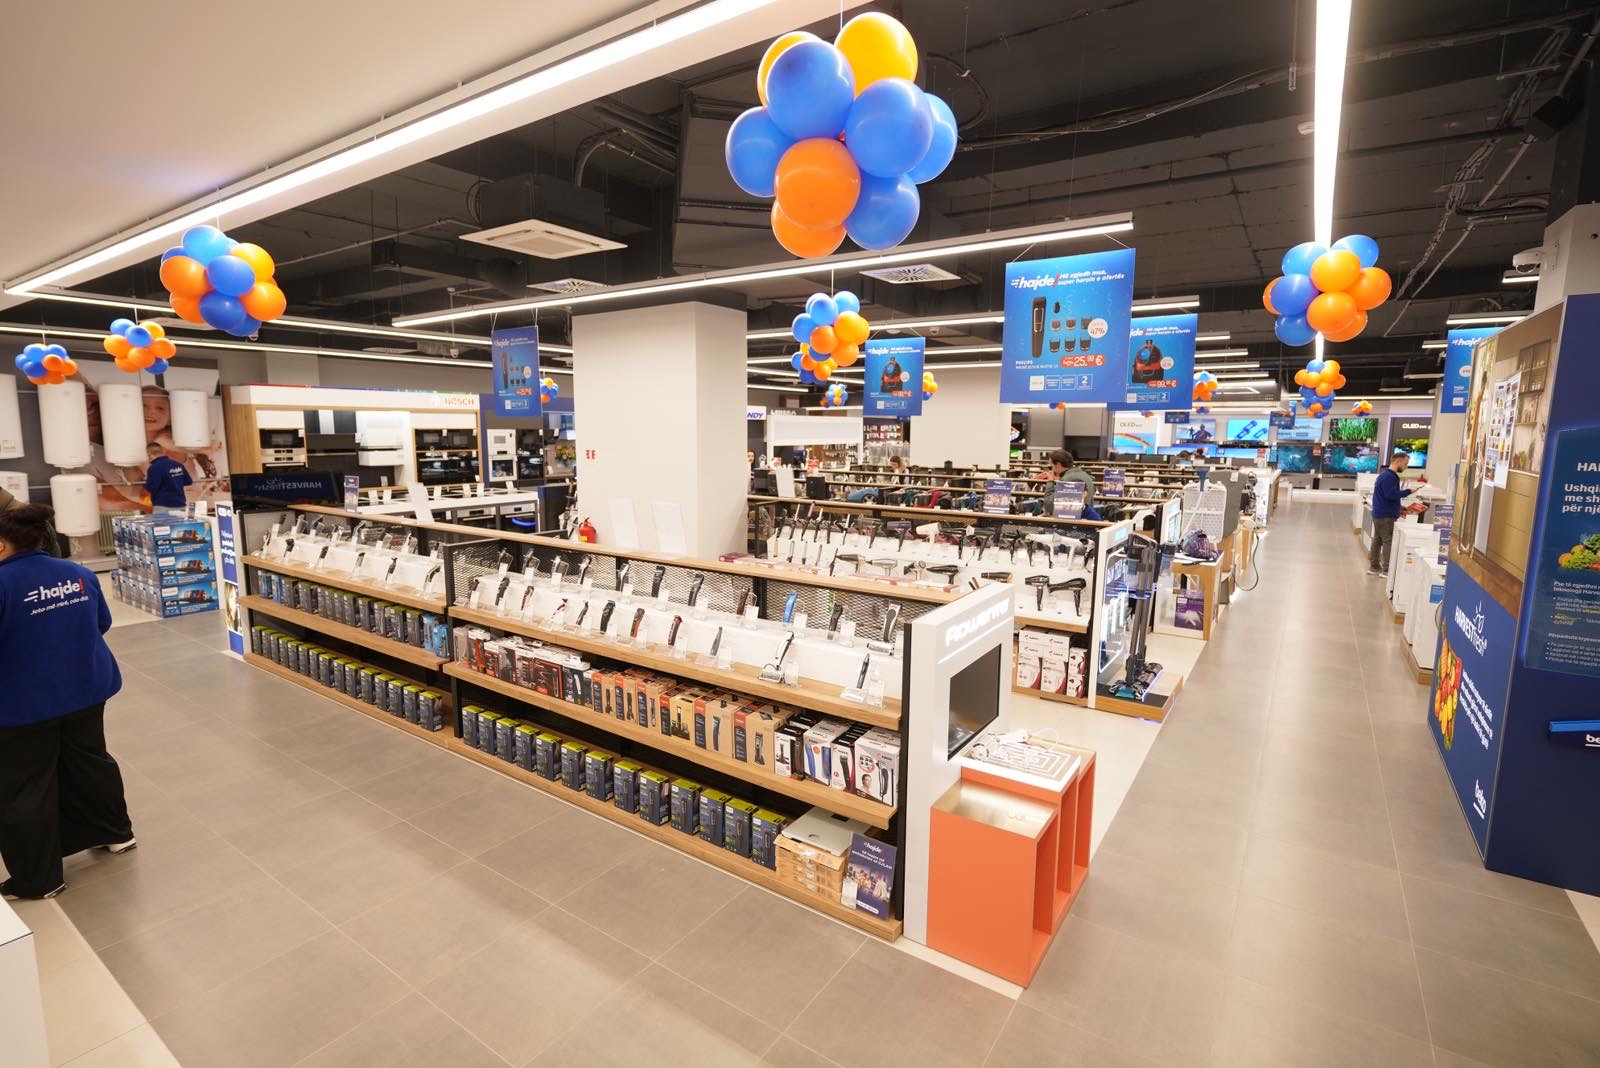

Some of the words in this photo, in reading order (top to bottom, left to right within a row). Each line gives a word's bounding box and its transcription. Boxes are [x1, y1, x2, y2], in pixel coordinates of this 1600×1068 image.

[1081, 376, 1088, 384] 2
[747, 411, 764, 419] NDY
[1577, 462, 1600, 472] HA
[1564, 483, 1600, 494] Ushqi
[1564, 495, 1584, 503] me
[1585, 494, 1600, 503] sh
[1562, 503, 1583, 513] për
